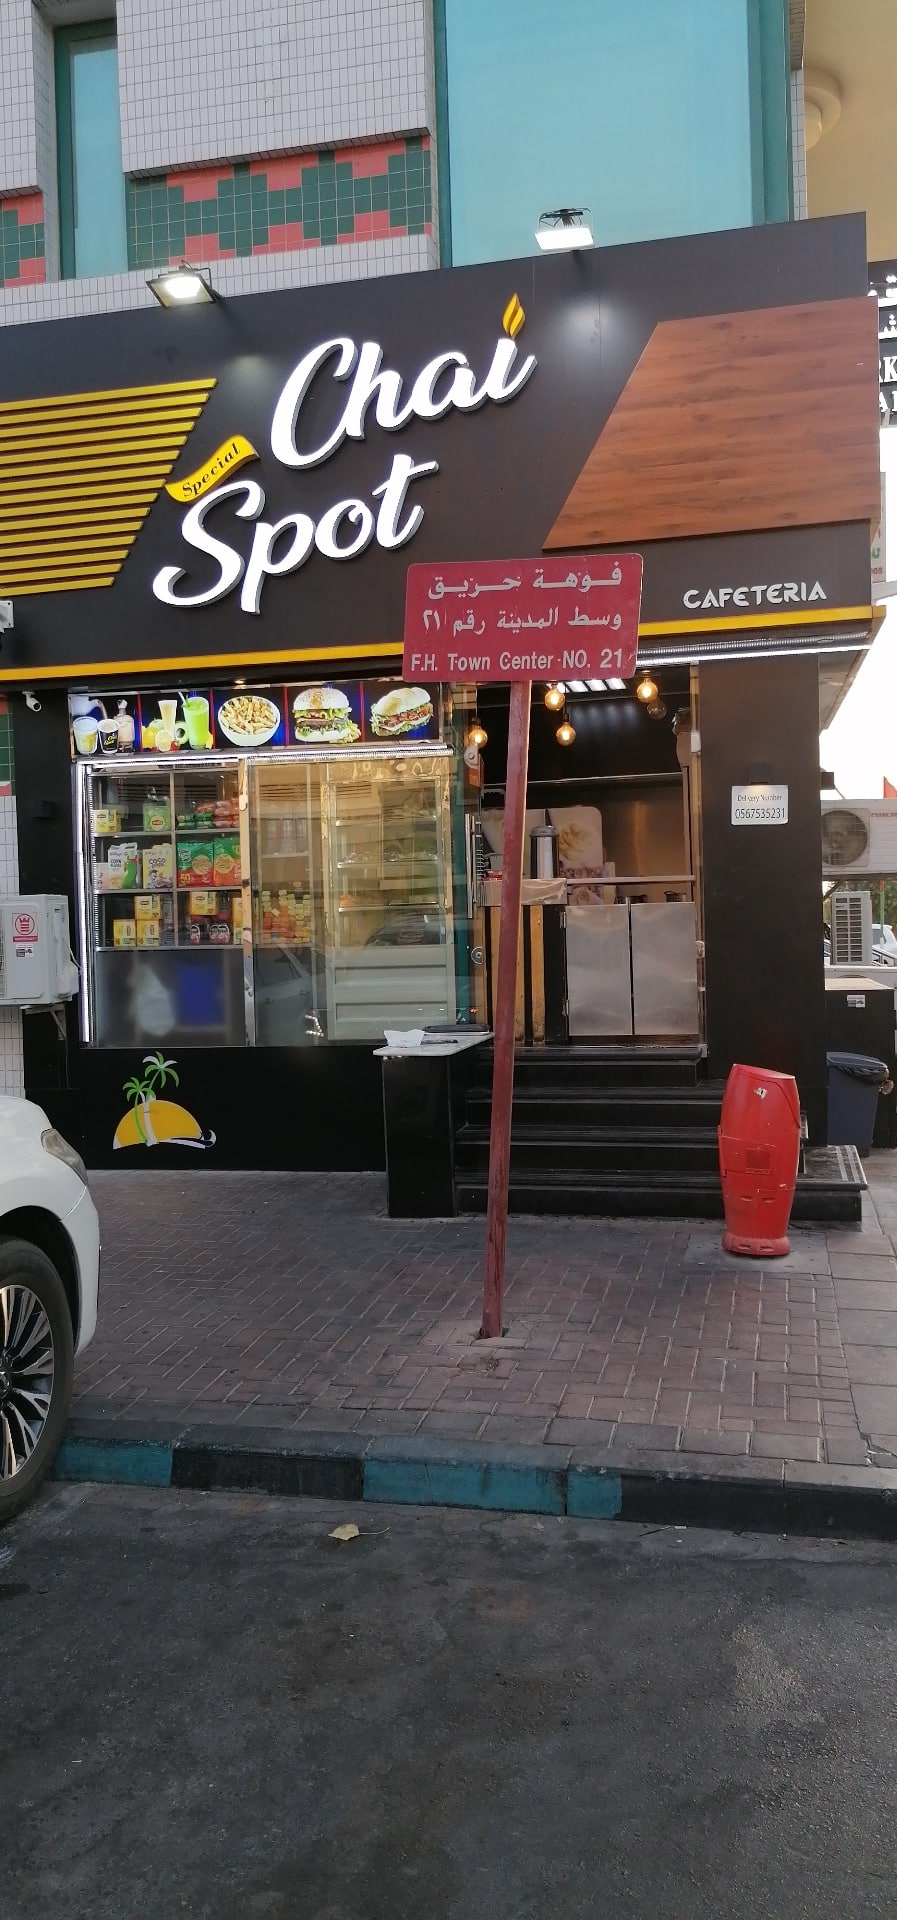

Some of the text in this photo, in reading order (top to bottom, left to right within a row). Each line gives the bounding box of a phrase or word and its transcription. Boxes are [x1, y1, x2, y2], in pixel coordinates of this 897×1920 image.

[271, 293, 538, 470] Chai
[181, 442, 241, 497] Special
[153, 454, 439, 614] Spot
[533, 561, 622, 592] فوهة
[683, 581, 827, 609] CAFETERIA
[453, 609, 485, 638] رقم
[497, 606, 559, 633] المدينة
[567, 606, 622, 631] وسط
[410, 648, 623, 672] F.H. Town Center NO. 21
[735, 807, 785, 819] 0567535231
